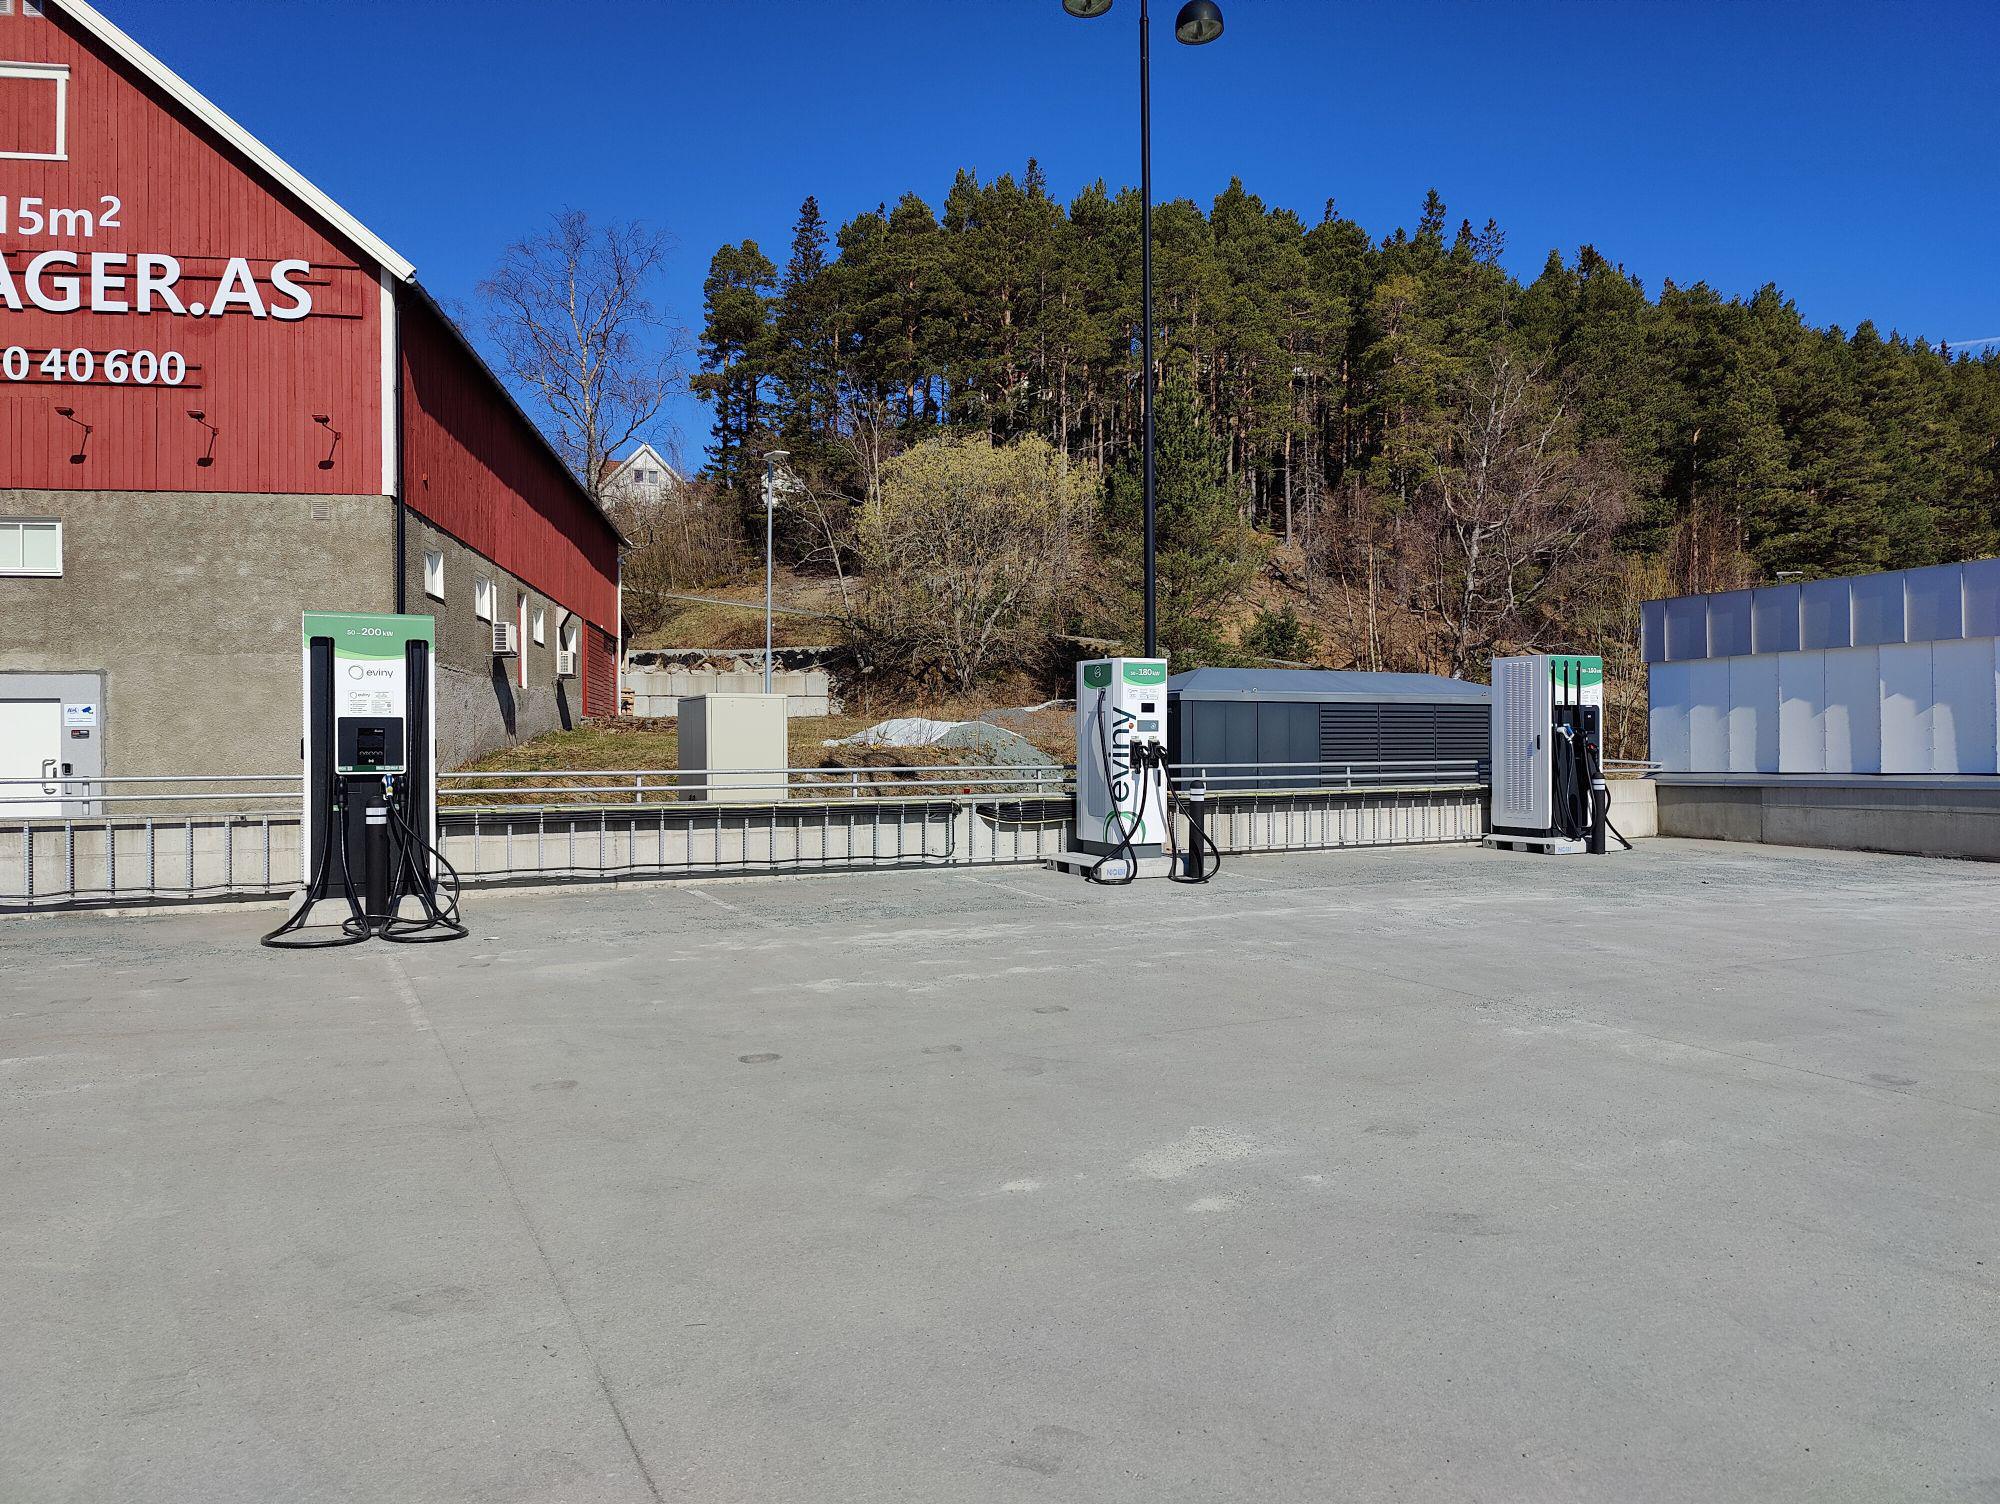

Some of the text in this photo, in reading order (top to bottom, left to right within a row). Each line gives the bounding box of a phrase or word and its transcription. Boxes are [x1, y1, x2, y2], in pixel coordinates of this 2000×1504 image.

[40, 348, 95, 382] 40
[103, 349, 186, 386] 600
[366, 668, 394, 678] eviny
[1112, 706, 1137, 803] eviny
